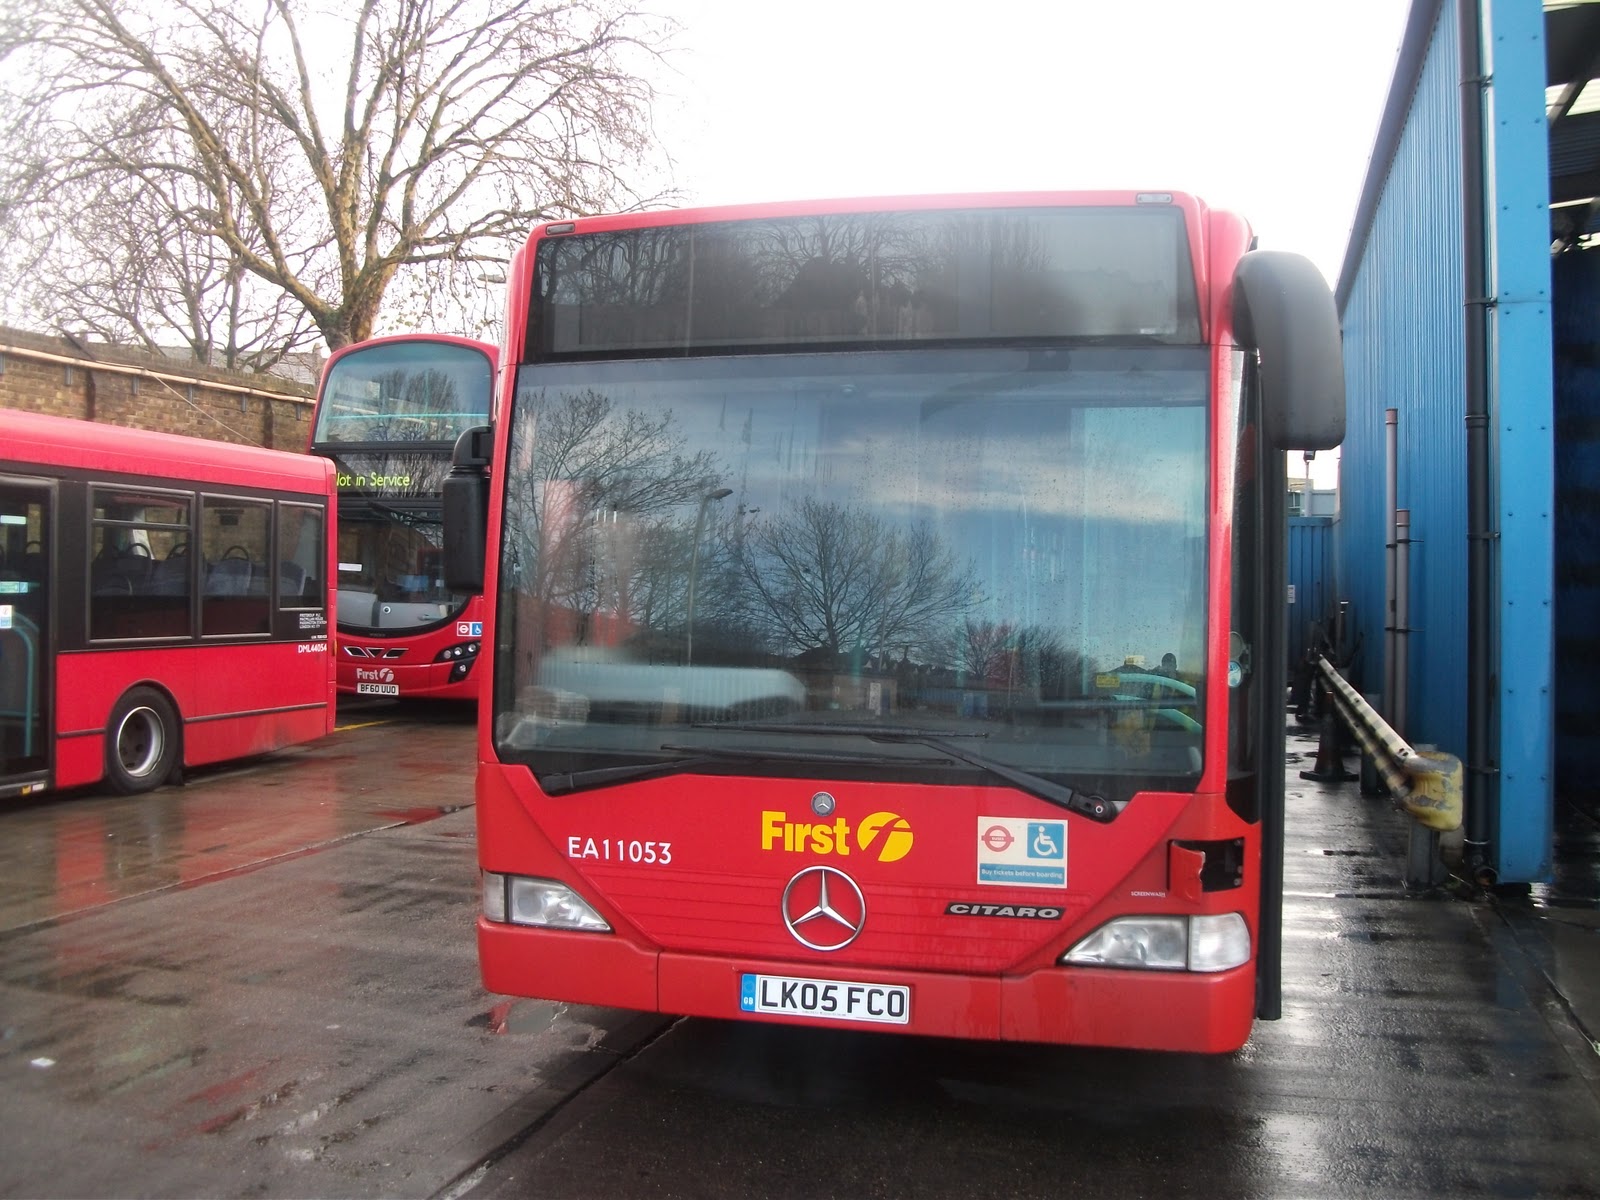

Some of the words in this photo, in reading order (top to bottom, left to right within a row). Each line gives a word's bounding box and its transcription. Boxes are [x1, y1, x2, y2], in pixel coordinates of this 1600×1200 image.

[356, 473, 366, 486] in
[370, 471, 410, 486] Service
[298, 643, 327, 653] DML44054
[356, 668, 379, 680] First
[360, 684, 380, 693] BF60
[762, 810, 850, 856] First
[568, 836, 672, 864] EA11053
[981, 868, 992, 876] Buy
[1036, 871, 1063, 879] boarding
[949, 904, 1060, 919] CITARO
[743, 996, 754, 1005] GB
[761, 979, 838, 1012] LK05
[847, 986, 905, 1018] FCO
